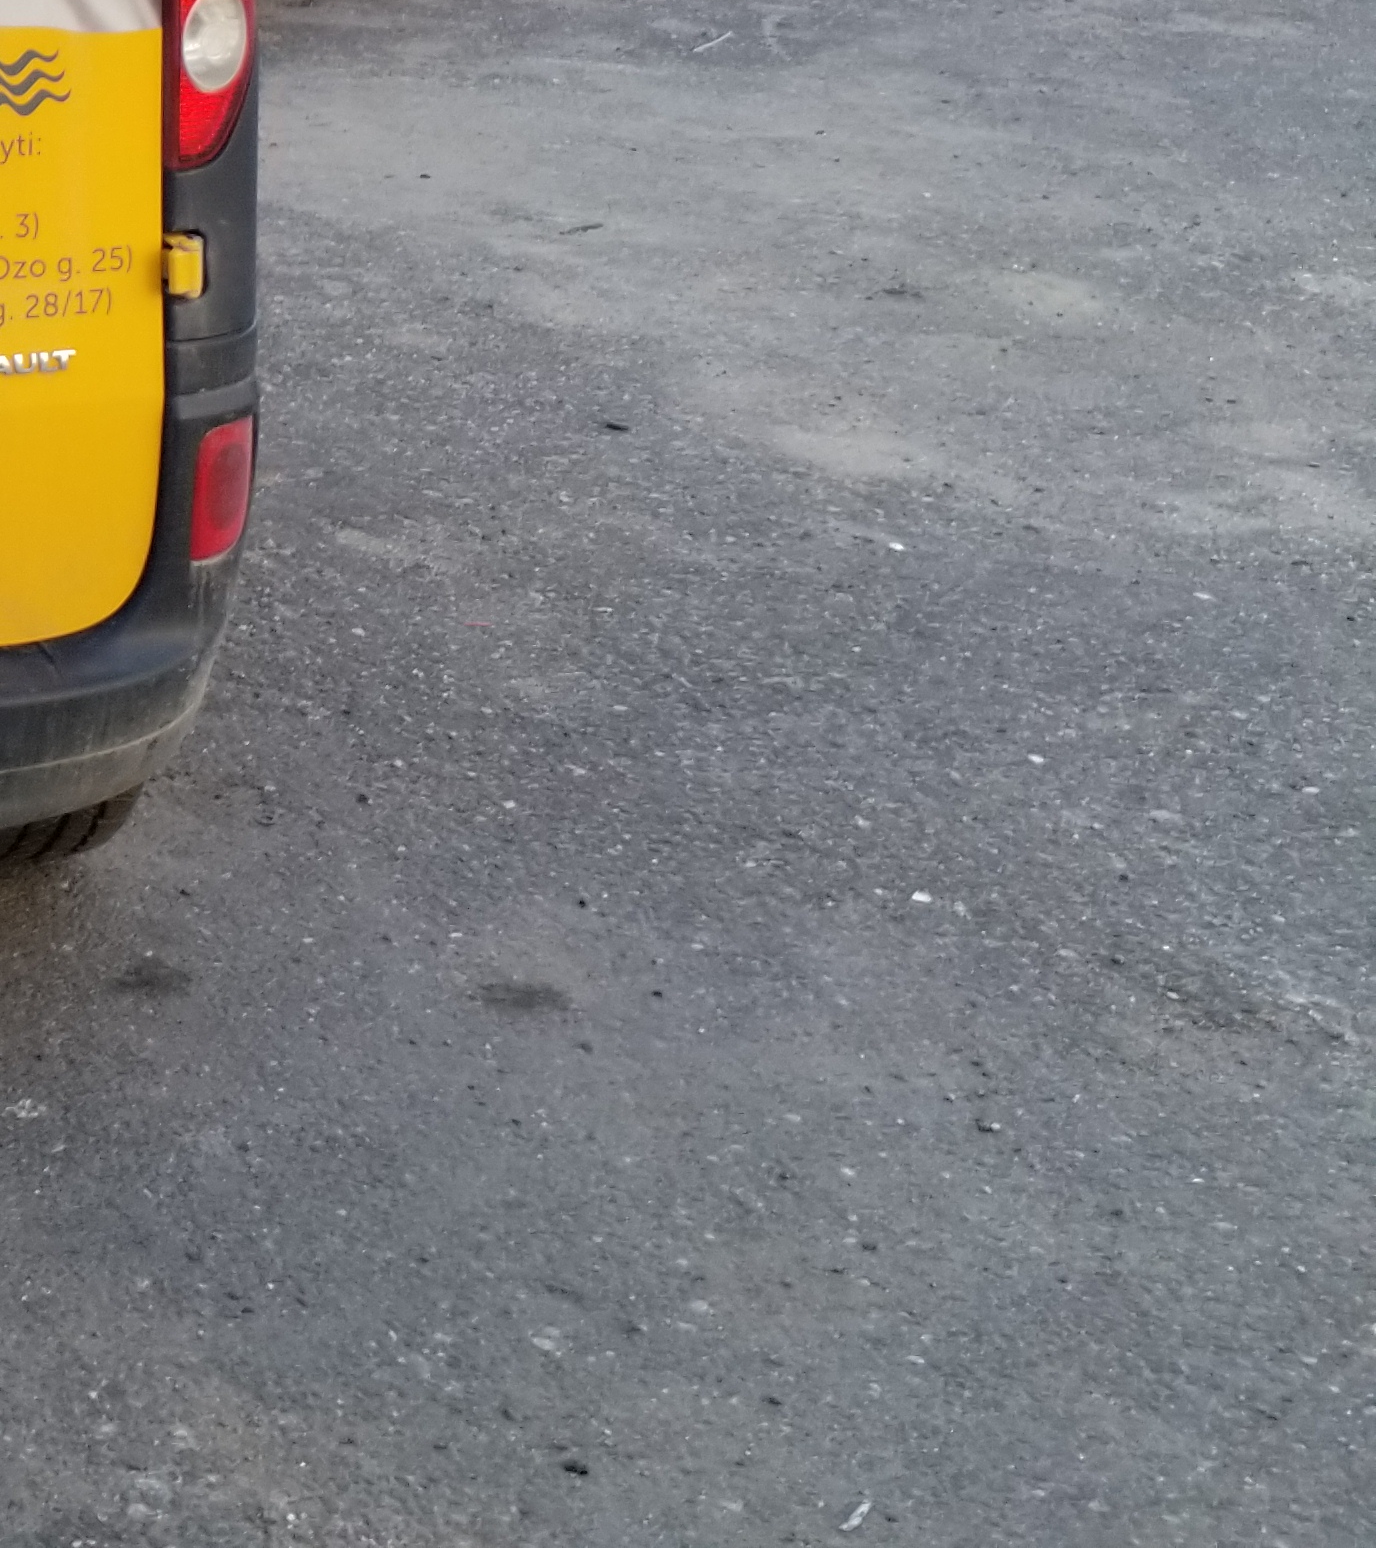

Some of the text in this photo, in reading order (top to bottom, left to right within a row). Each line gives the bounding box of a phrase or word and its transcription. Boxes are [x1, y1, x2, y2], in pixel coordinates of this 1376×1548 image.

[15, 212, 39, 240] 3)
[57, 257, 81, 282] g.
[92, 245, 132, 273] 25)
[25, 287, 112, 319] 28/17)
